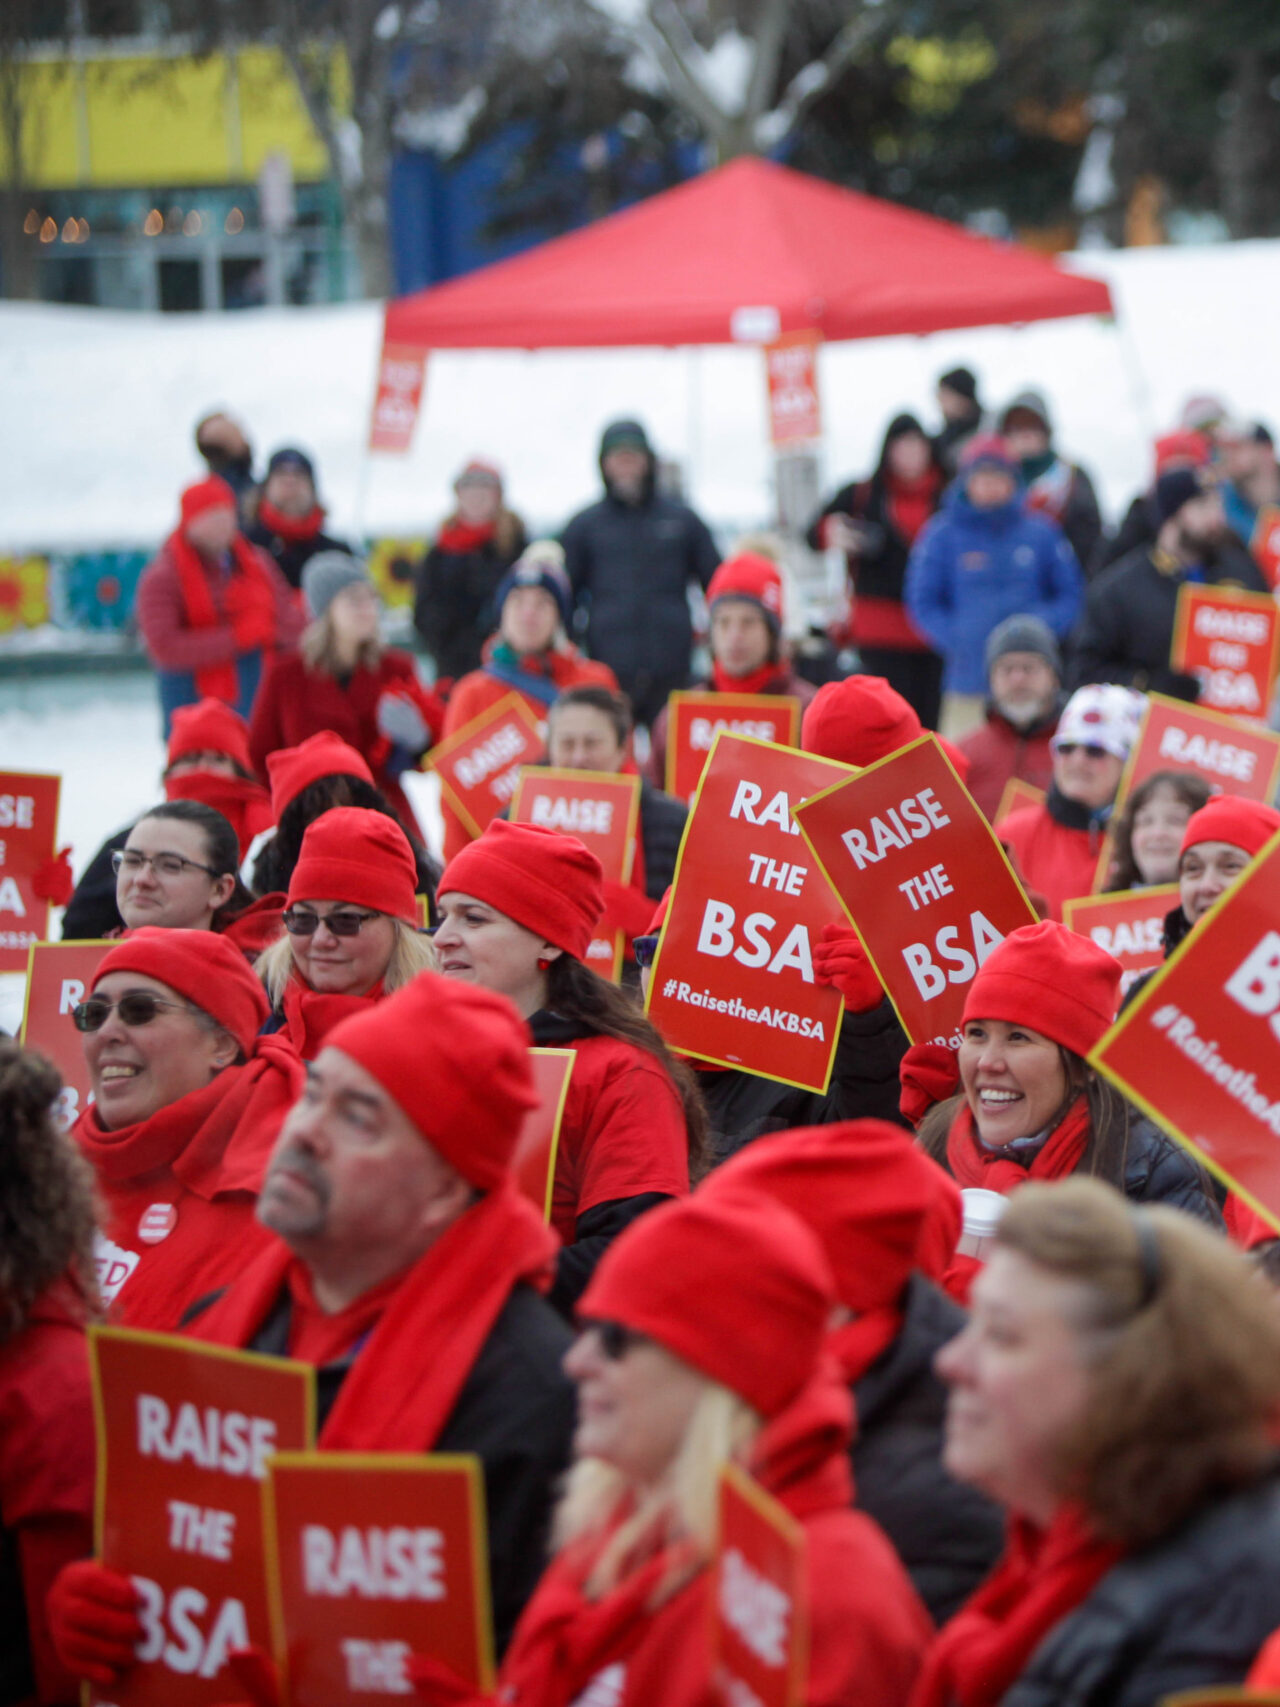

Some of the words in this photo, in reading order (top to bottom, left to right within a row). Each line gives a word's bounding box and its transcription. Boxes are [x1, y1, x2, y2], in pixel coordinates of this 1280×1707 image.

[453, 723, 527, 790] RAISE
[1161, 726, 1258, 783] RAISE
[530, 795, 614, 834] RAISE
[841, 787, 951, 870] RAISE
[749, 853, 808, 897] THE
[899, 864, 954, 910] THE
[697, 899, 816, 985] BSA
[902, 911, 1007, 1001] BSA
[1090, 917, 1165, 958] RAIS
[663, 979, 826, 1042] #RaisetheAKBSA
[136, 1394, 278, 1481] RAISE
[167, 1500, 236, 1563] THE
[302, 1524, 447, 1601] RAISE
[340, 1638, 416, 1695] THE
